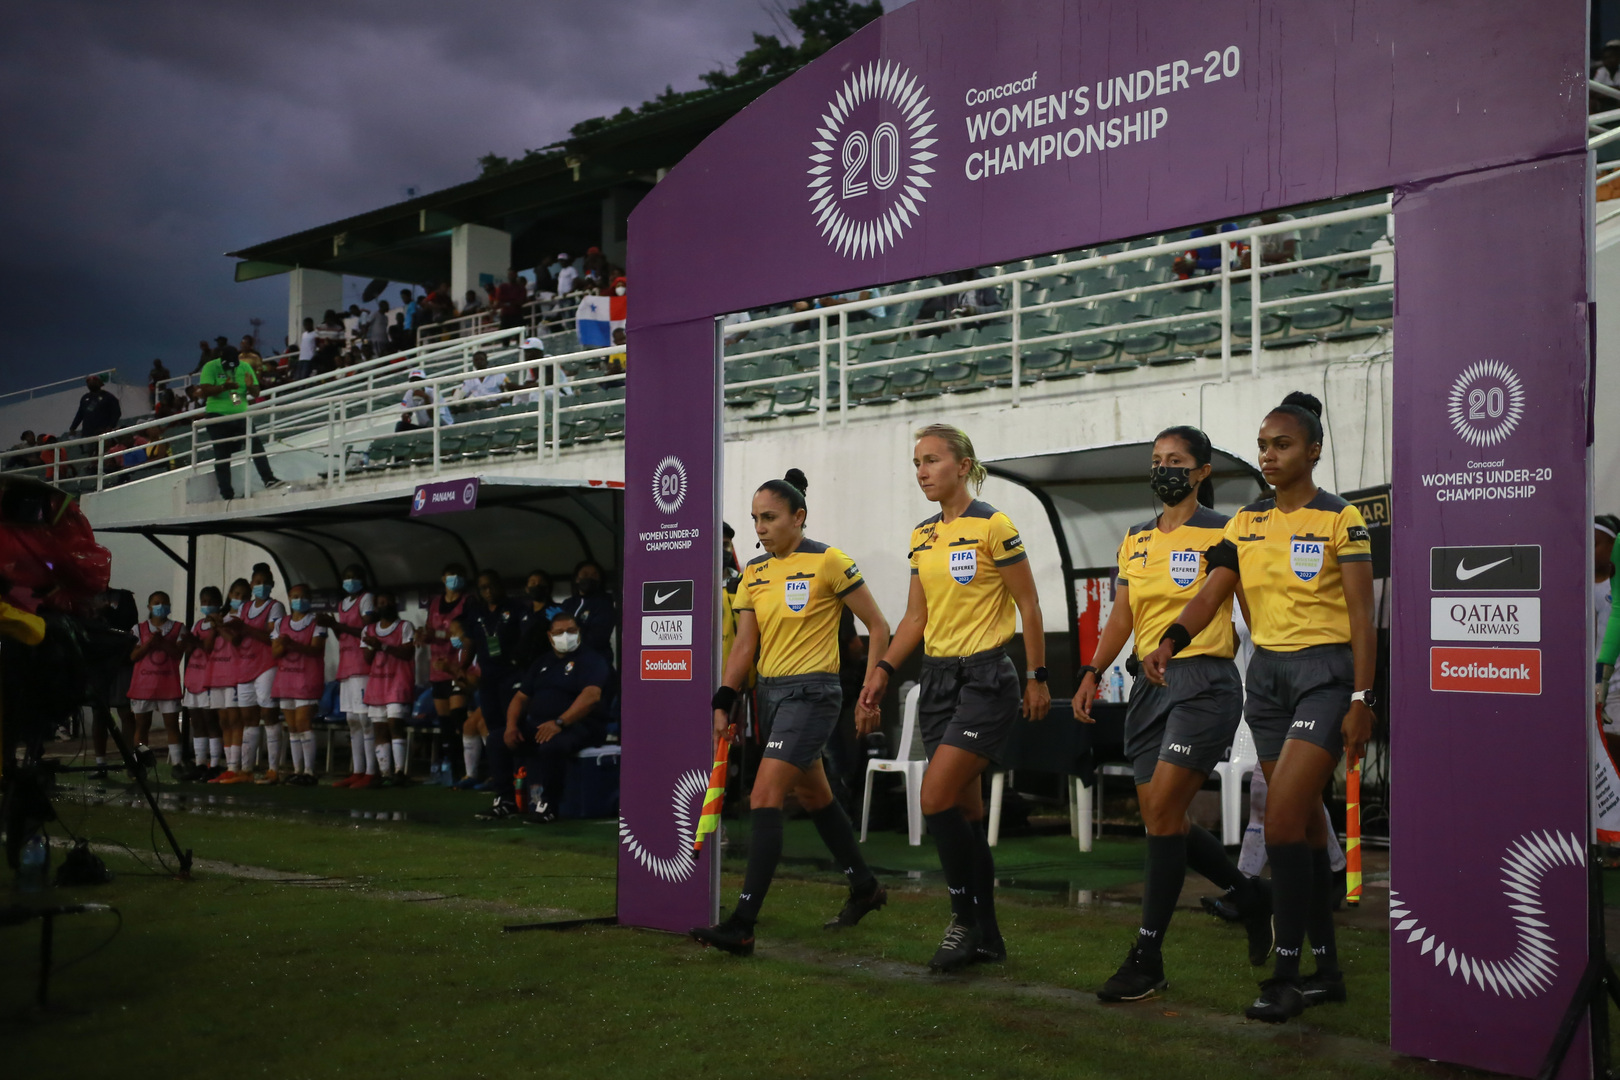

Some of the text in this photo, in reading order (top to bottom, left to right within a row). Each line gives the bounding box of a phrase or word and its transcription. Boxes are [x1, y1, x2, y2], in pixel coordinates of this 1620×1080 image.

[965, 71, 1038, 107] Concacaf
[965, 45, 1240, 143] WOMEN'S UNDER-20
[965, 107, 1168, 181] CHAMPIONSHIP
[841, 121, 899, 200] 20
[1468, 387, 1504, 420] 20
[1466, 459, 1505, 469] Concacaf
[661, 473, 679, 496] 20
[1421, 467, 1552, 487] WOMEN'S UNDER-20
[432, 491, 455, 503] PANAMA
[1436, 485, 1536, 502] CHAMPIONSHIP
[1358, 502, 1385, 521] AR
[639, 528, 700, 541] WOMEN'S UNDER-20
[646, 540, 692, 551] CHAMPIONSHIP
[1294, 543, 1320, 554] FIFA
[952, 551, 974, 561] FIFA
[1172, 552, 1197, 562] FIFA
[787, 582, 807, 591] FIFA
[1450, 604, 1519, 625] QATAR
[650, 620, 683, 635] QATAR
[1467, 623, 1520, 635] AIRWAYS
[658, 632, 683, 641] AIRWAYS
[645, 659, 687, 670] Scotiabank
[1440, 661, 1530, 680] Scotiabank
